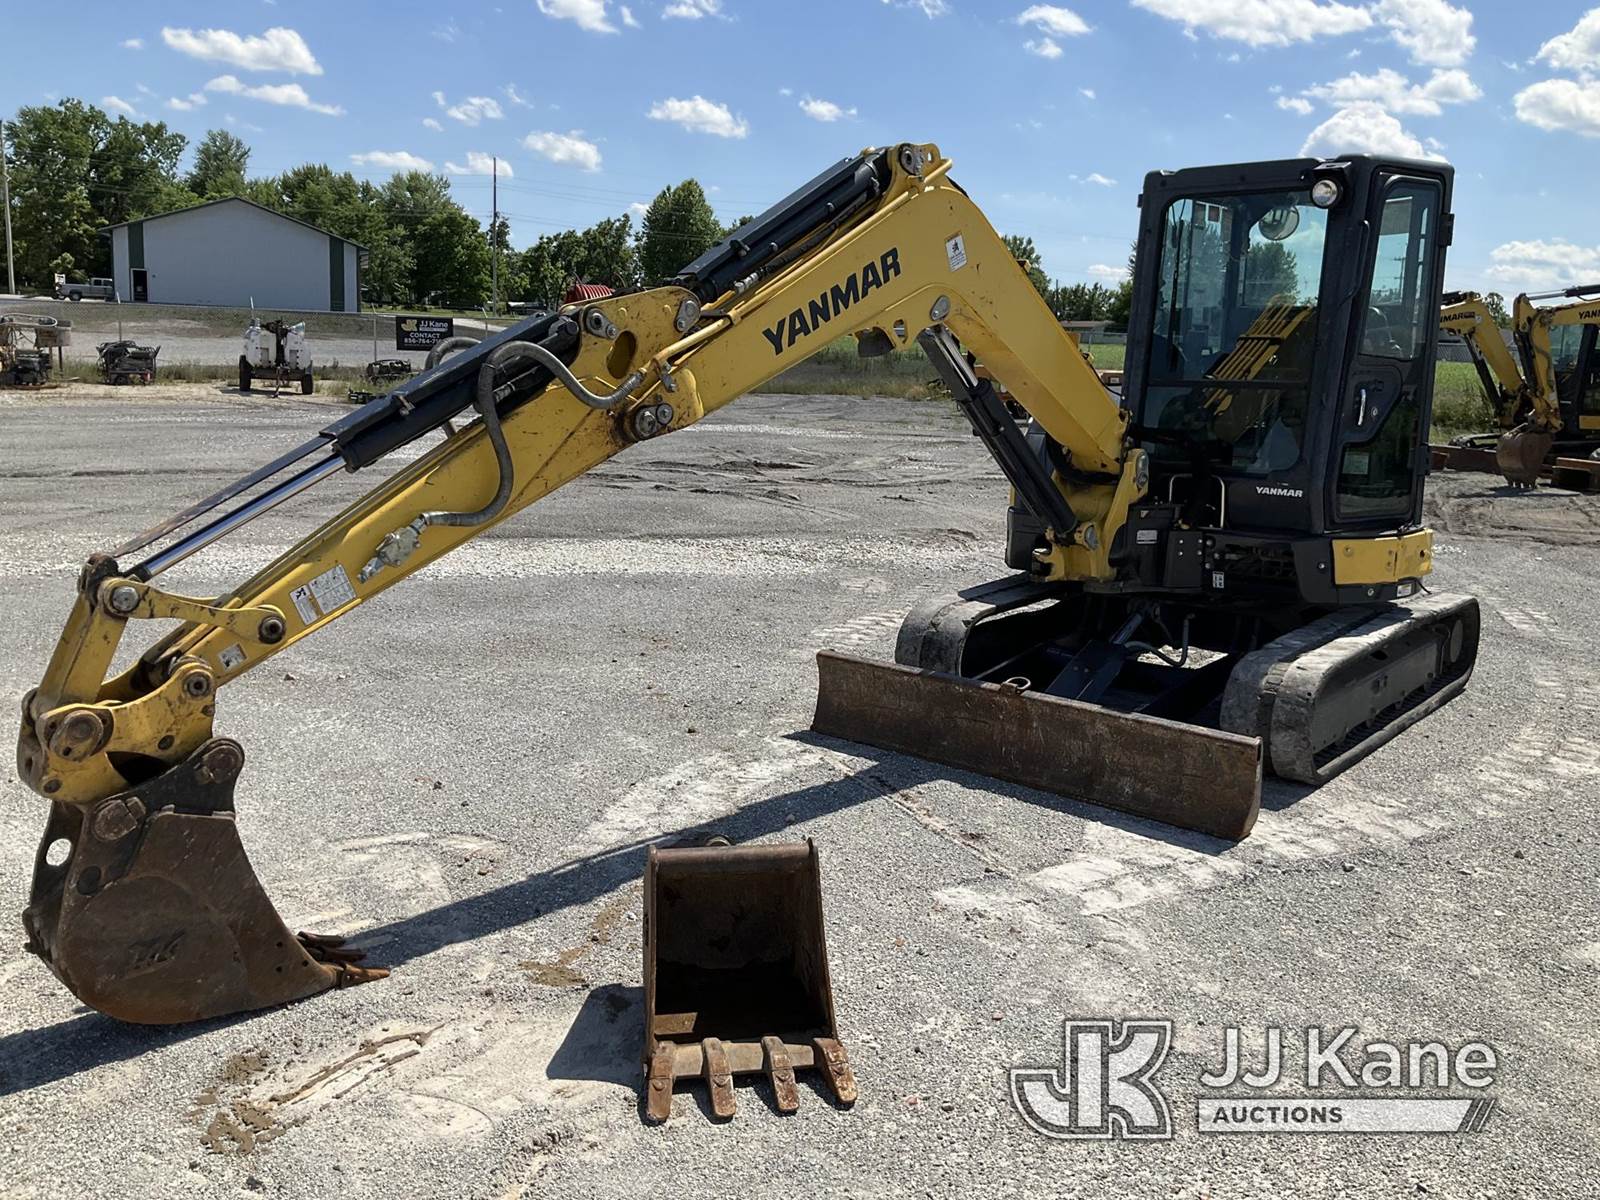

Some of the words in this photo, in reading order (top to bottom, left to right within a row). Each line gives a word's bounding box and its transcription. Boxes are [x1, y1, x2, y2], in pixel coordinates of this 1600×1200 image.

[762, 247, 901, 356] YANMAR
[429, 320, 448, 328] Kane
[1255, 486, 1304, 498] YANMAR
